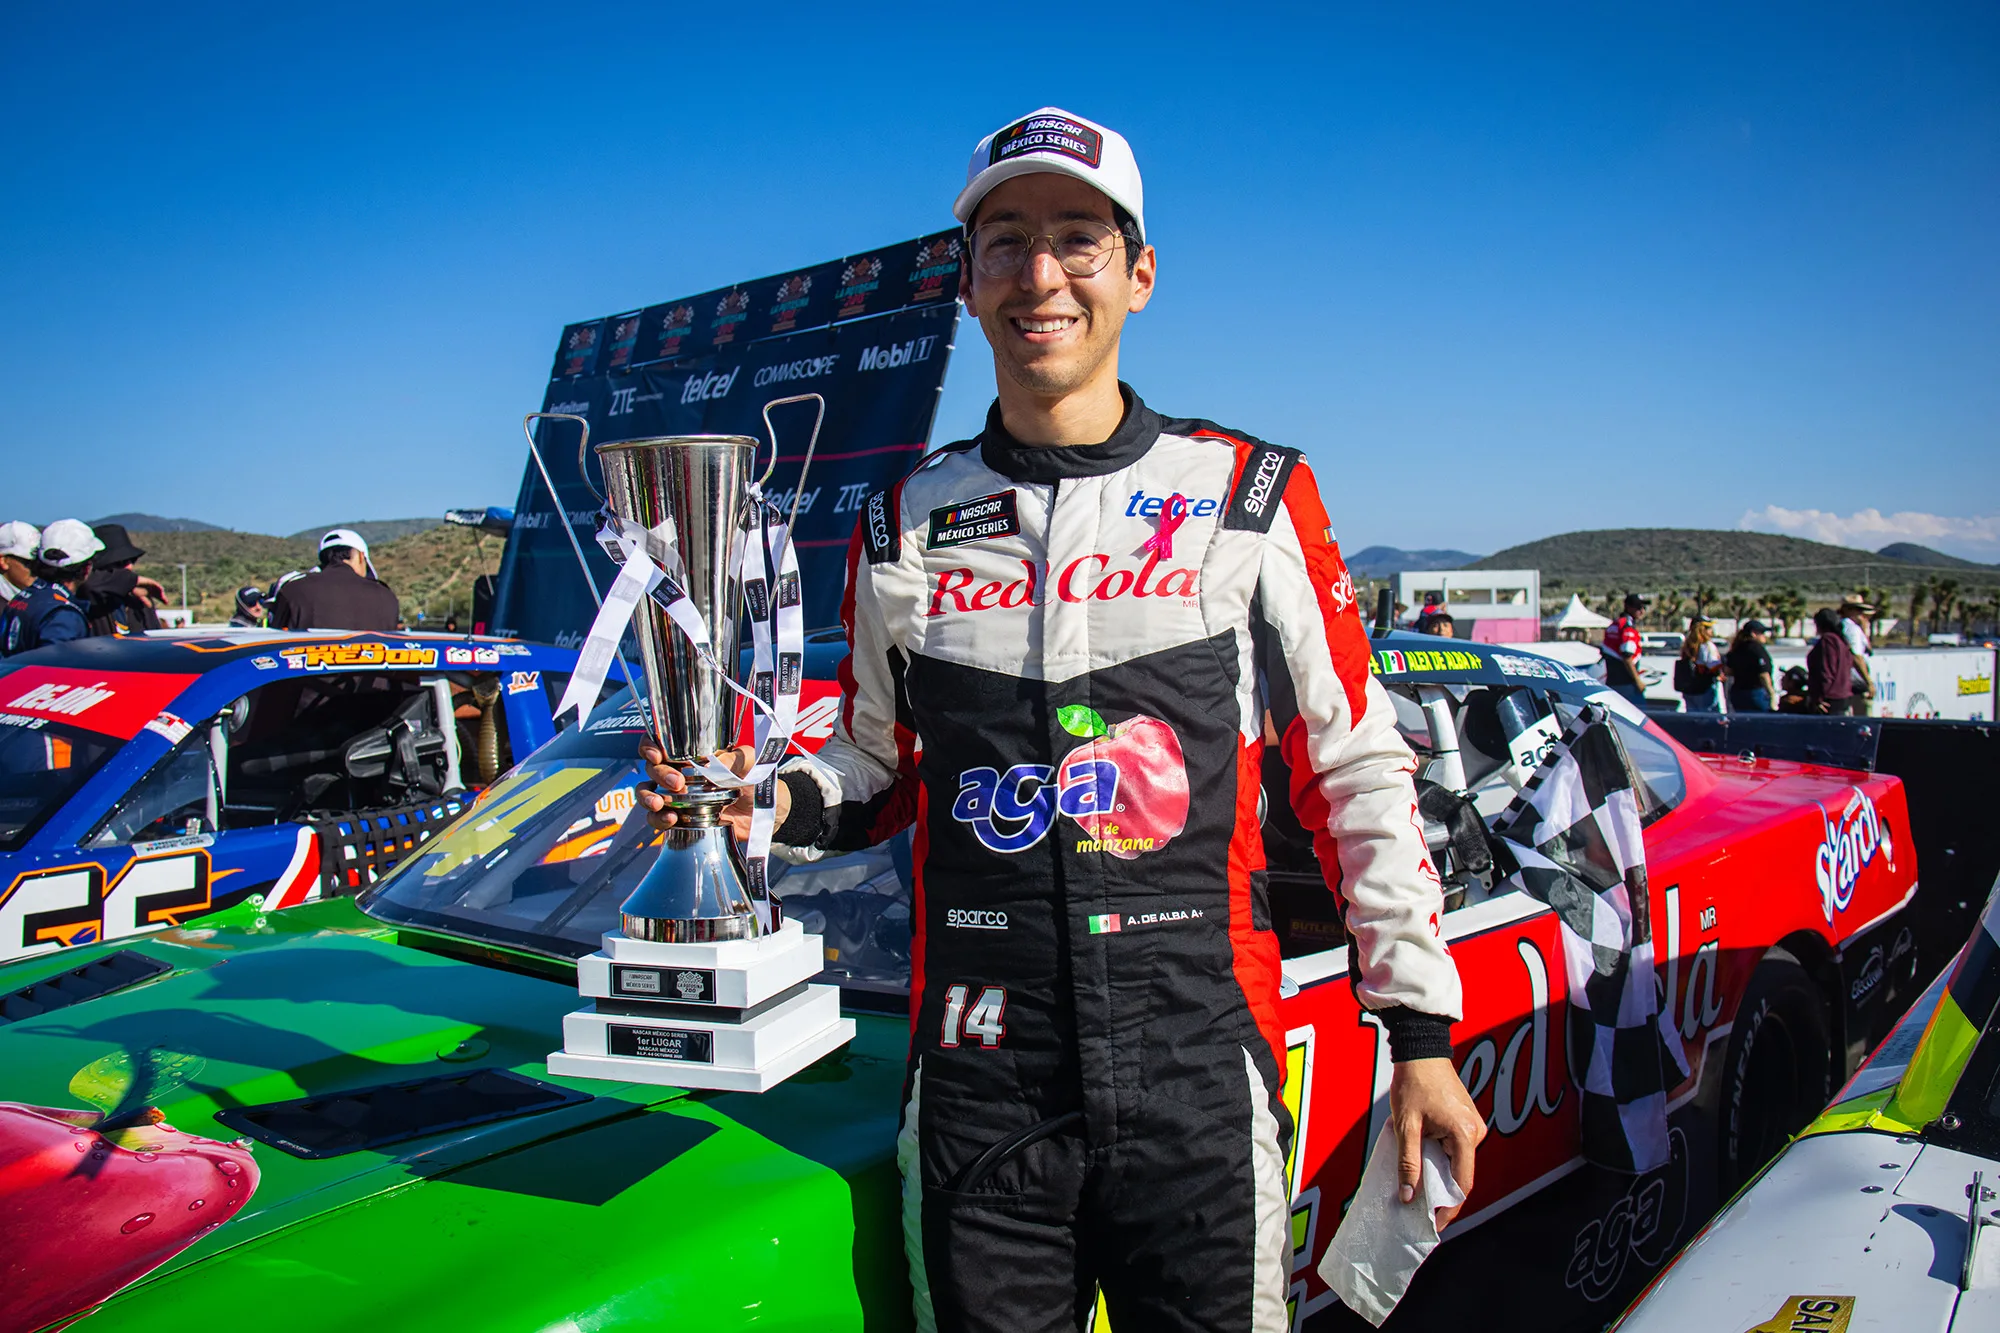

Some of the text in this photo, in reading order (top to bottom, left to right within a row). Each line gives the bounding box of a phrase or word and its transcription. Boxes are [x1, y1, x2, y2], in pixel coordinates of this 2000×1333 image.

[1026, 120, 1082, 136] NASCAR
[1001, 133, 1087, 156] MÉXICO SERIES
[608, 387, 637, 417] ZTE
[681, 365, 740, 405] telcel
[753, 356, 835, 388] COMMSCOPE
[858, 344, 914, 372] Mobil
[1244, 451, 1282, 518] sparco
[833, 482, 870, 513] ZTE
[1125, 490, 1228, 518] tecel
[869, 491, 890, 548] sparco
[959, 500, 1002, 521] NASCAR
[937, 519, 1009, 542] MÉXICO SERIES
[922, 550, 1202, 617] Red Cola
[1182, 600, 1199, 608] MR
[306, 648, 436, 666] REJON
[1406, 651, 1432, 671] ALEX
[1432, 651, 1445, 671] DE
[1445, 651, 1469, 671] ALBA
[952, 760, 1120, 853] aga
[1090, 822, 1119, 835] el de
[1076, 837, 1154, 853] manzana
[947, 908, 1008, 928] sparco
[1127, 909, 1204, 925] A. DE ALBA A+
[1699, 906, 1718, 932] MR
[942, 985, 1005, 1048] 14
[636, 1037, 682, 1048] 1er LUGAR
[671, 1031, 688, 1039] SERIES
[1565, 1178, 1665, 1302] aga
